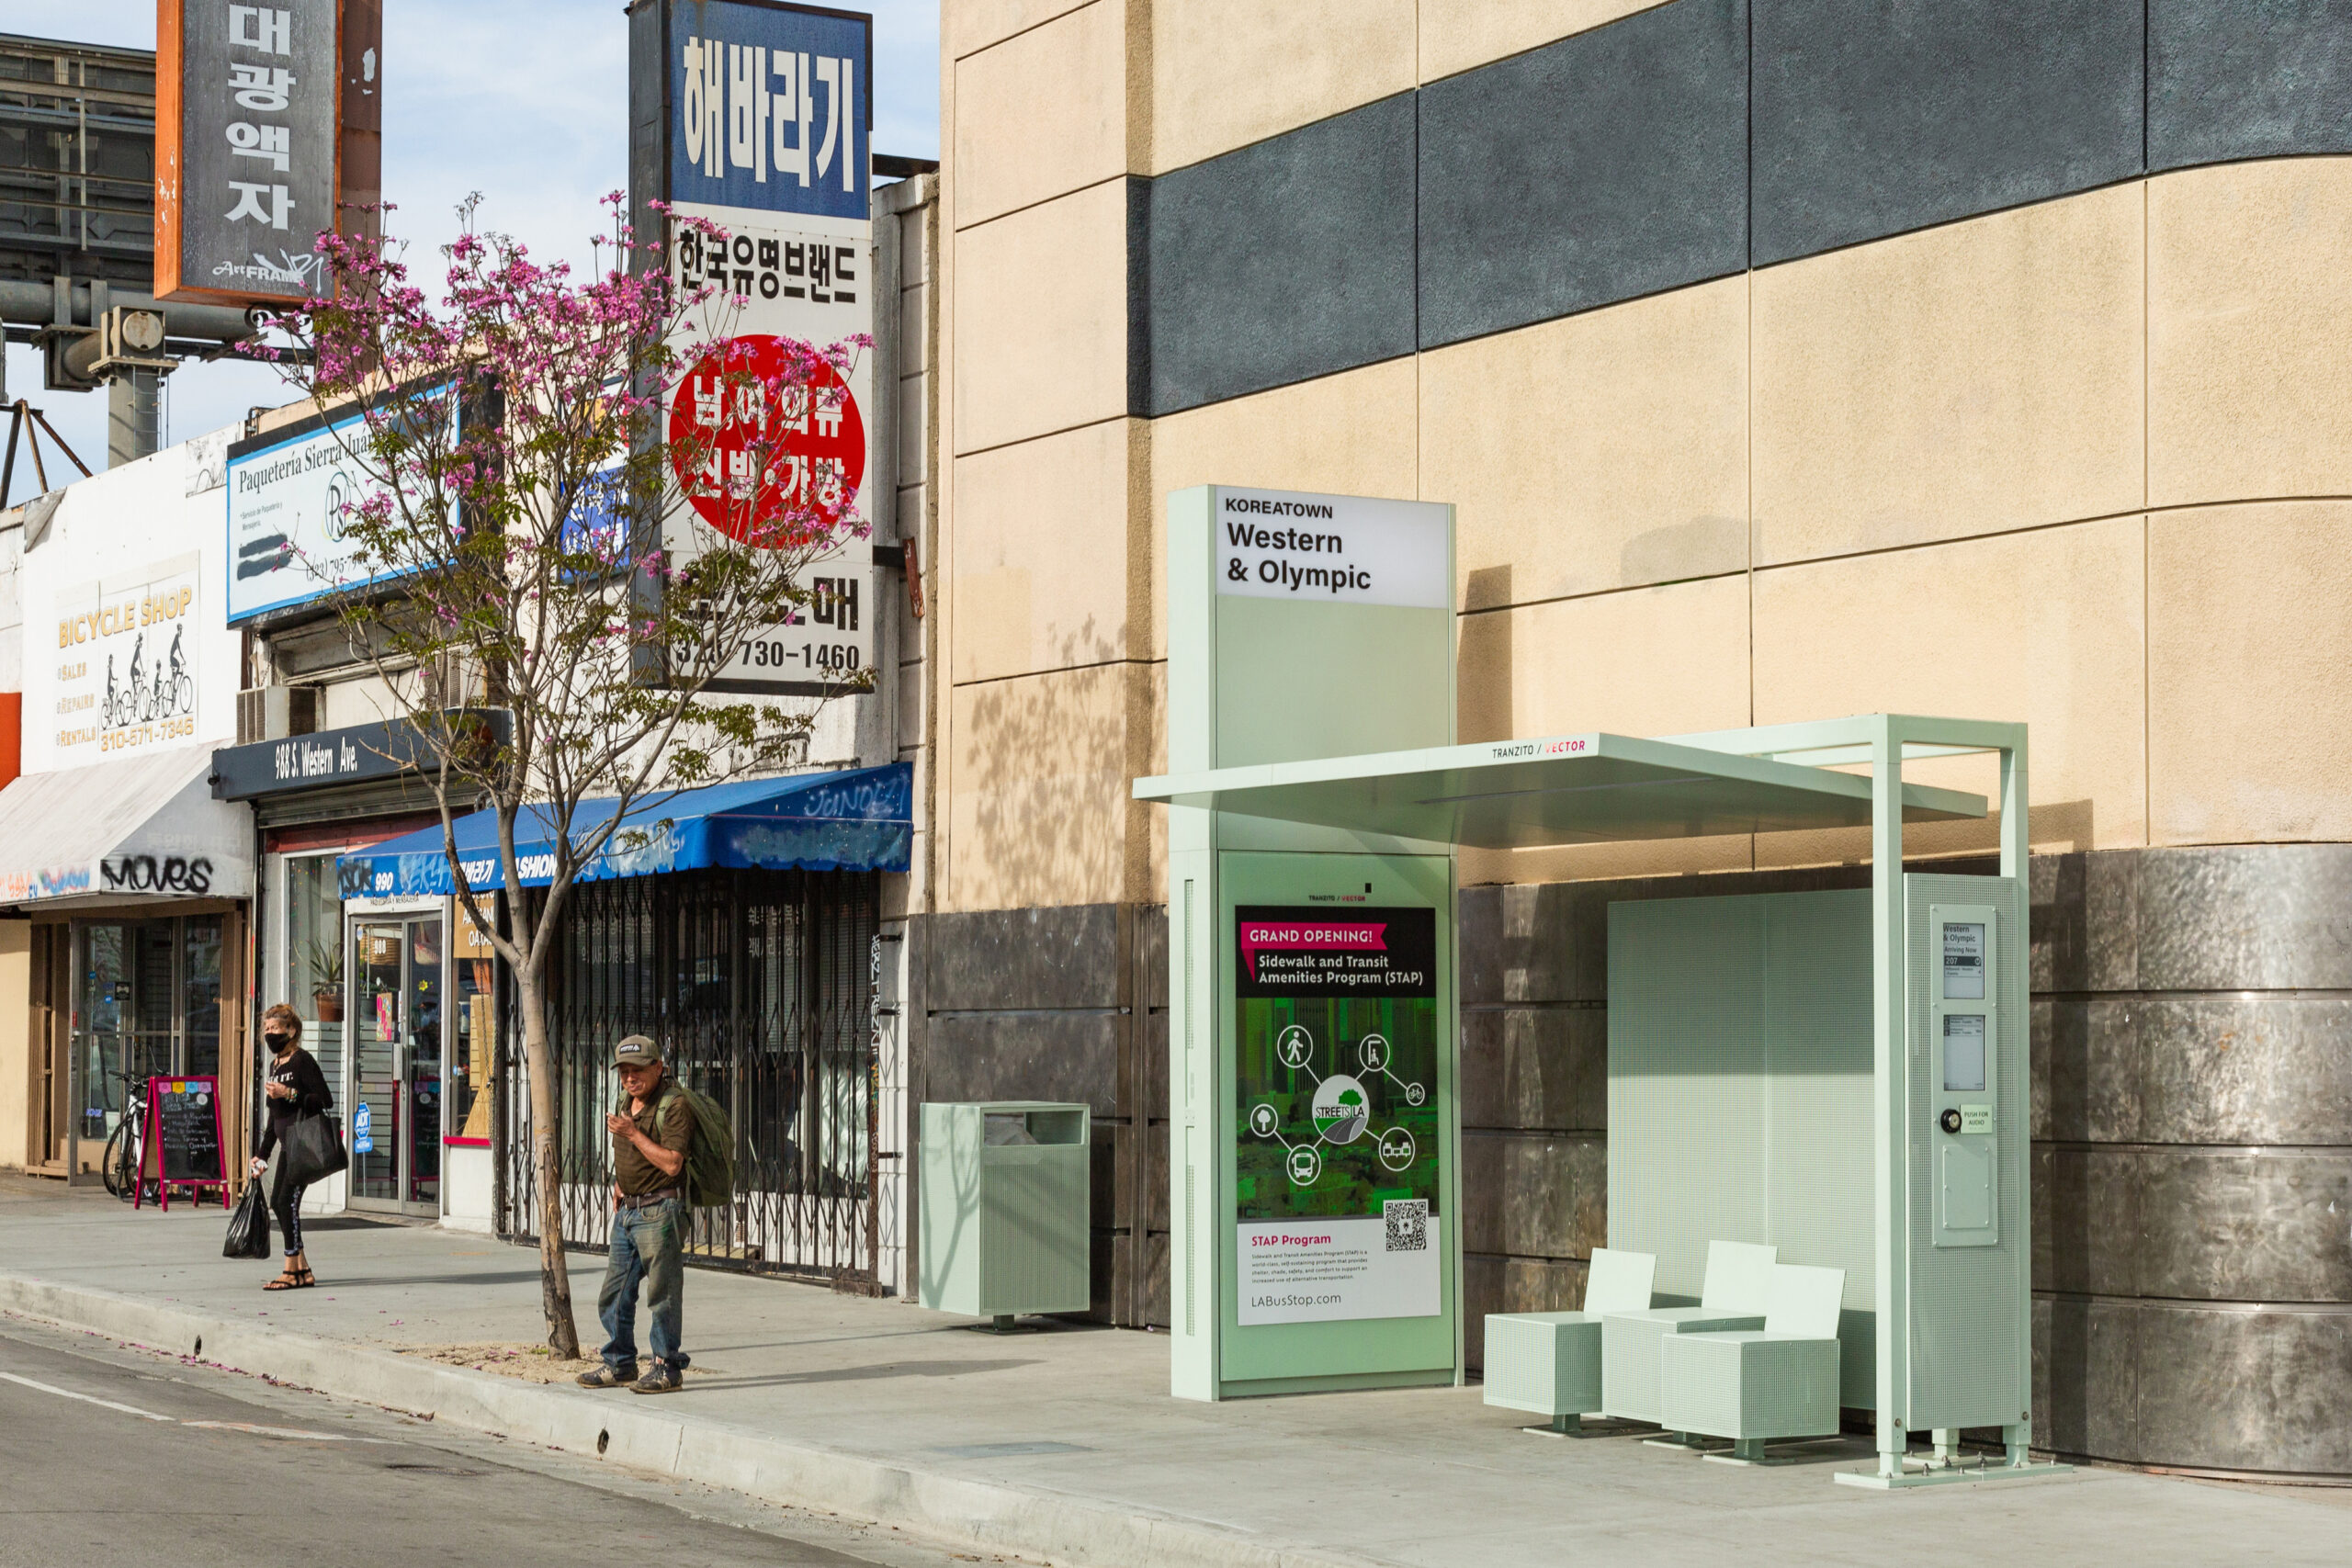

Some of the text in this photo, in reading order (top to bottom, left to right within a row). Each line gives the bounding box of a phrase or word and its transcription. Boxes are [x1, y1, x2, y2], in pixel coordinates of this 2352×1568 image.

[223, 4, 297, 230] 대광액자
[683, 35, 854, 193] 해바라기
[679, 229, 856, 304] 한국유명브랜드
[239, 449, 302, 494] Paquetería
[304, 443, 343, 471] Sierra
[1226, 497, 1333, 520] KOREATOWN
[1227, 522, 1342, 554] Western
[1227, 557, 1372, 593] & Olympic
[59, 583, 193, 649] BICYCLE SHOP
[100, 716, 195, 752] 310-571-7346
[276, 736, 358, 780] 988 S. Western Ave.
[1492, 744, 1534, 759] TRANZITO
[1544, 739, 1586, 754] VECTOR
[502, 854, 559, 882] SHION
[375, 871, 394, 891] 990
[1250, 930, 1374, 943] GRAND OPENING!
[1943, 925, 1970, 933] Western
[1950, 934, 1976, 943] Olympic
[1259, 954, 1389, 968] Sidewalk and Transit
[1944, 946, 1965, 954] Arriving
[1259, 970, 1424, 987] Amenities Program (STAP)
[1251, 1235, 1331, 1247] STAP Program
[1251, 1294, 1341, 1307] LABusStop.com
